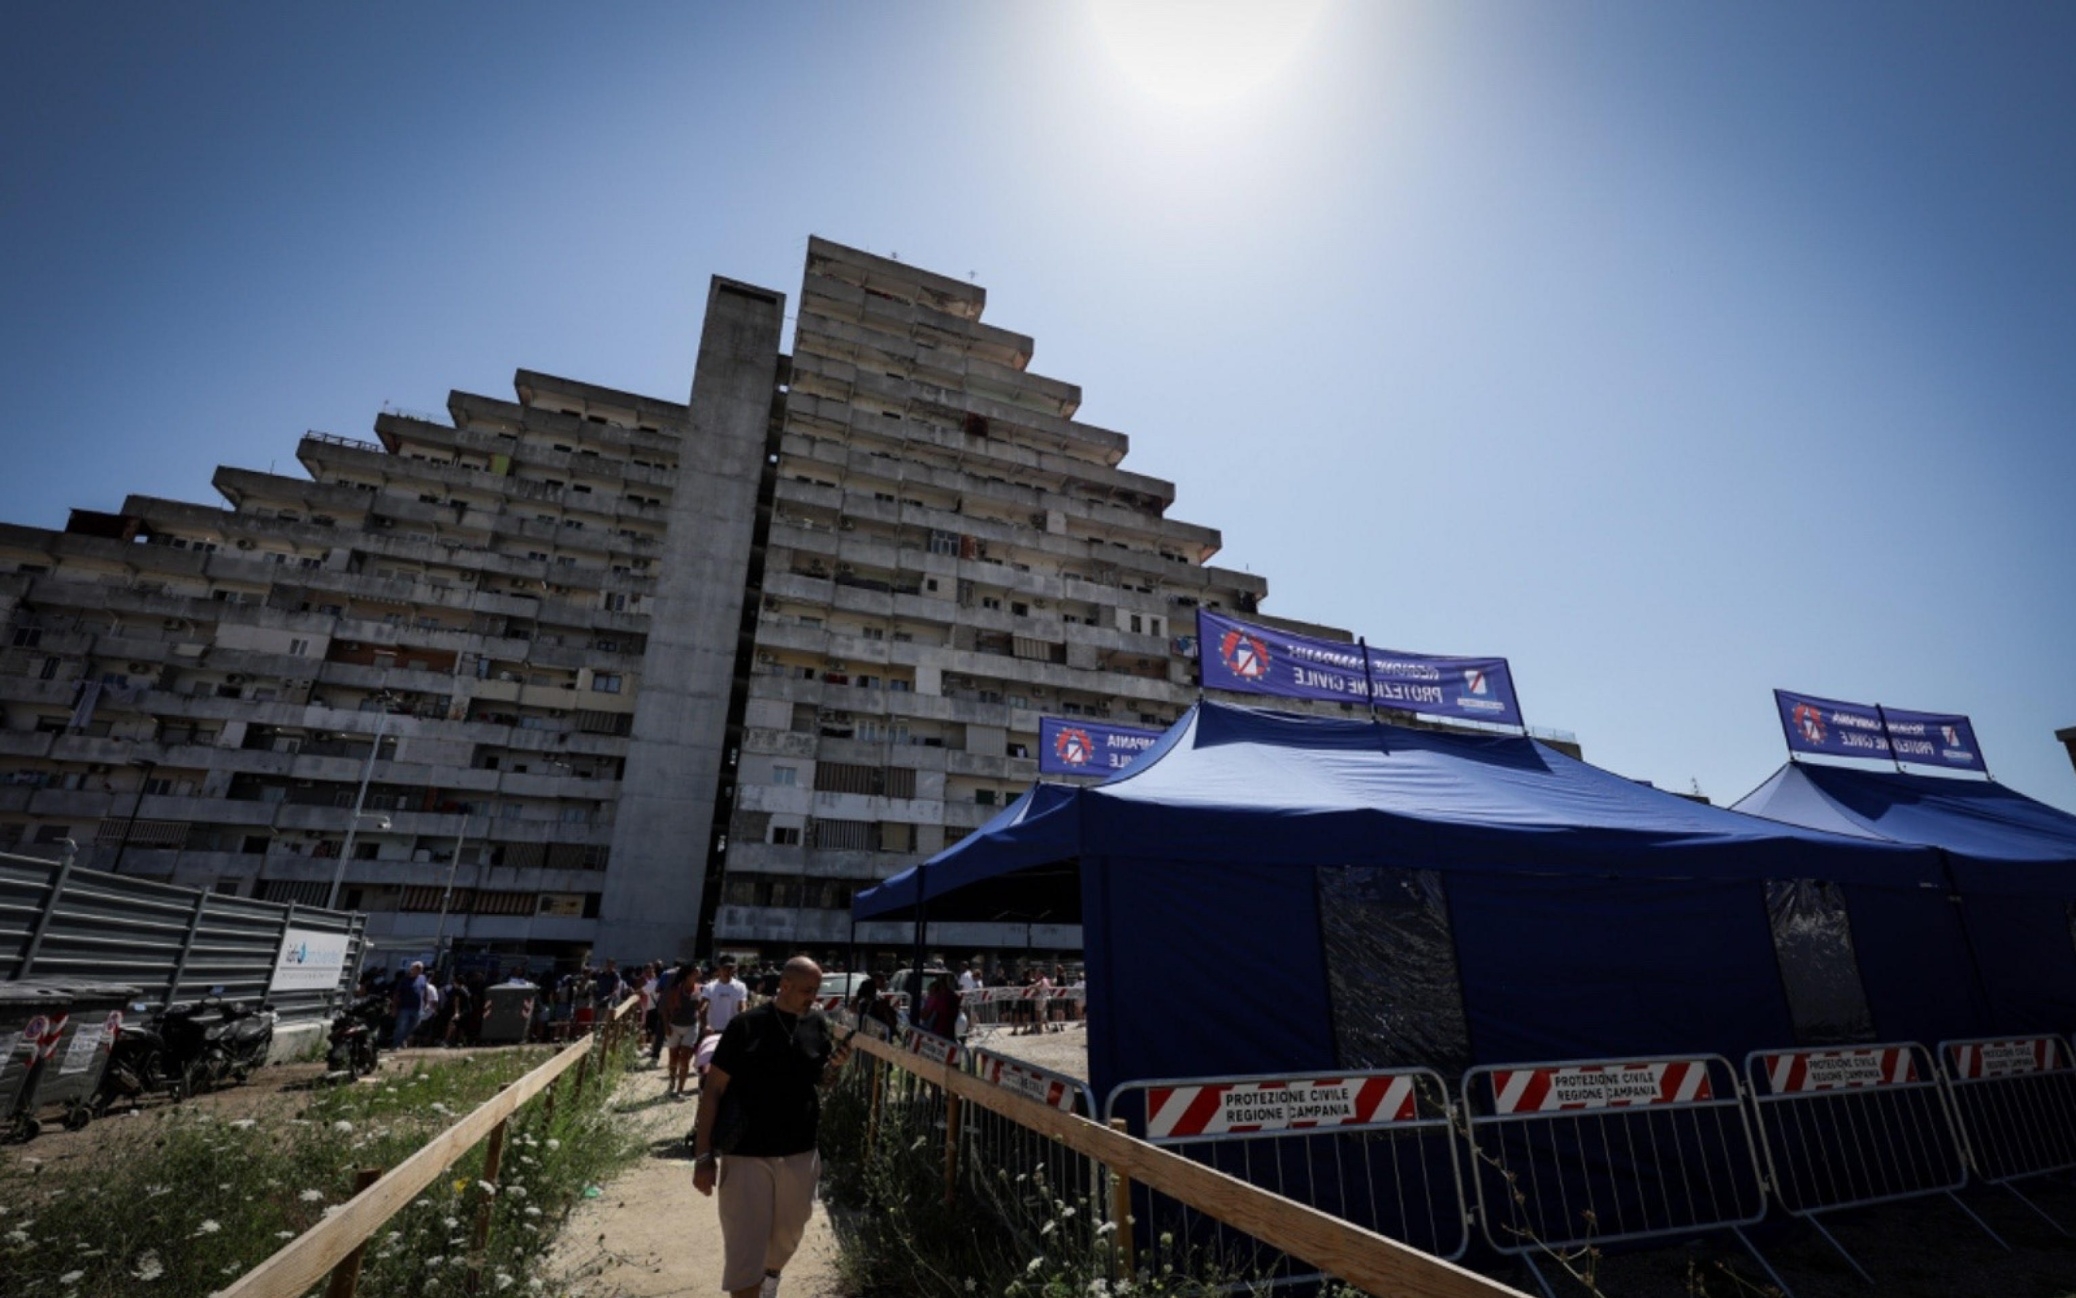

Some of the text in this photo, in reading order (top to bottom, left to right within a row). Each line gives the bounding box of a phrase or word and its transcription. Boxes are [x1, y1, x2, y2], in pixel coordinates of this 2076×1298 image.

[1555, 1072, 1655, 1087] PROTEZIONE CIVILE
[1226, 1088, 1348, 1106] PROTEZIONE CIVILE
[1557, 1086, 1657, 1101] REGIONE CAMPANIA
[1226, 1104, 1351, 1122] REGIONE CAMPANIA
